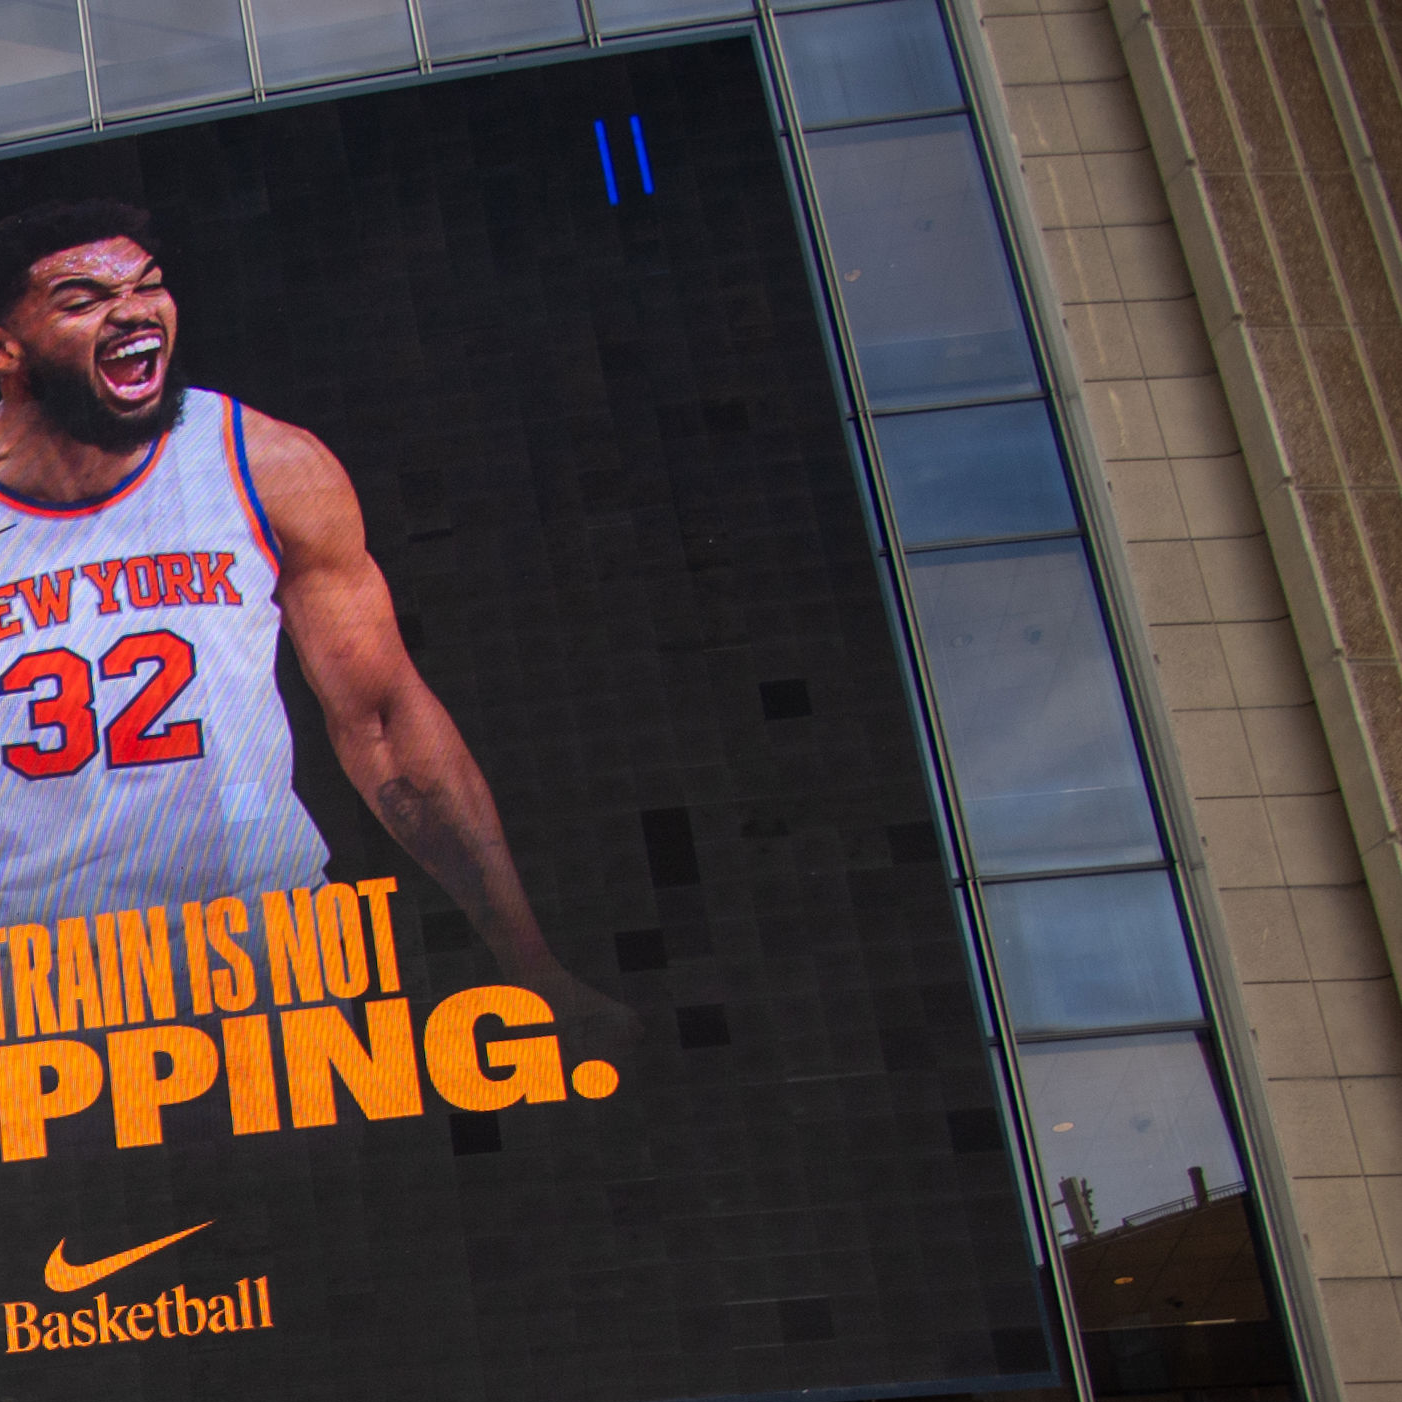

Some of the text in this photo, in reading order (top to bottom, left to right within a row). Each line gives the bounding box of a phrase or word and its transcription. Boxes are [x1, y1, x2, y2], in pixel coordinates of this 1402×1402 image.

[81, 551, 244, 615] YORK
[181, 894, 260, 1018] IS
[260, 876, 401, 1006] NOT
[1, 1275, 276, 1355] Basketball
